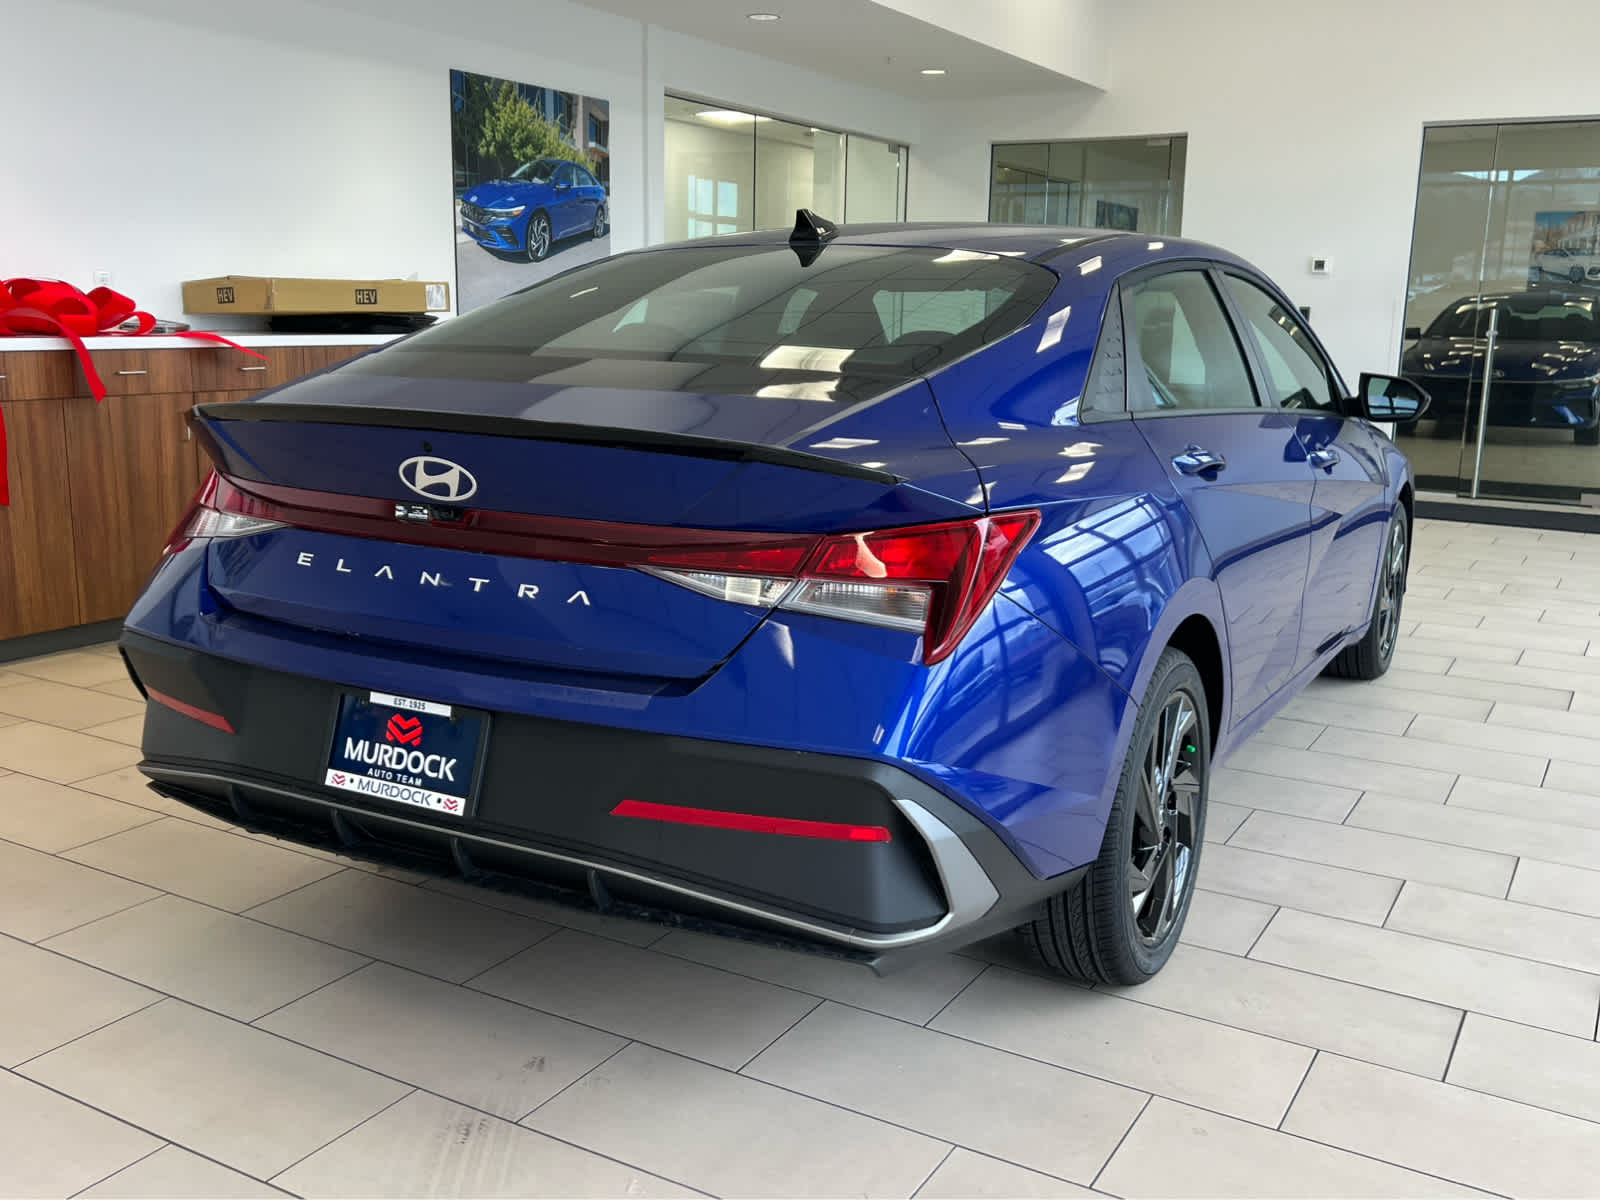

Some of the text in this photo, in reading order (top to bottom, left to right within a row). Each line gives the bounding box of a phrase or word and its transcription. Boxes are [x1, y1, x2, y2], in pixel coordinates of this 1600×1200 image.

[217, 288, 234, 303] HEV
[356, 290, 377, 304] HEV
[296, 552, 591, 606] ELANTRA
[393, 697, 426, 711] EST. 1925
[344, 736, 457, 782] MURDOCK
[367, 767, 423, 787] AUTO TEAM
[357, 778, 432, 807] MURDOCK
